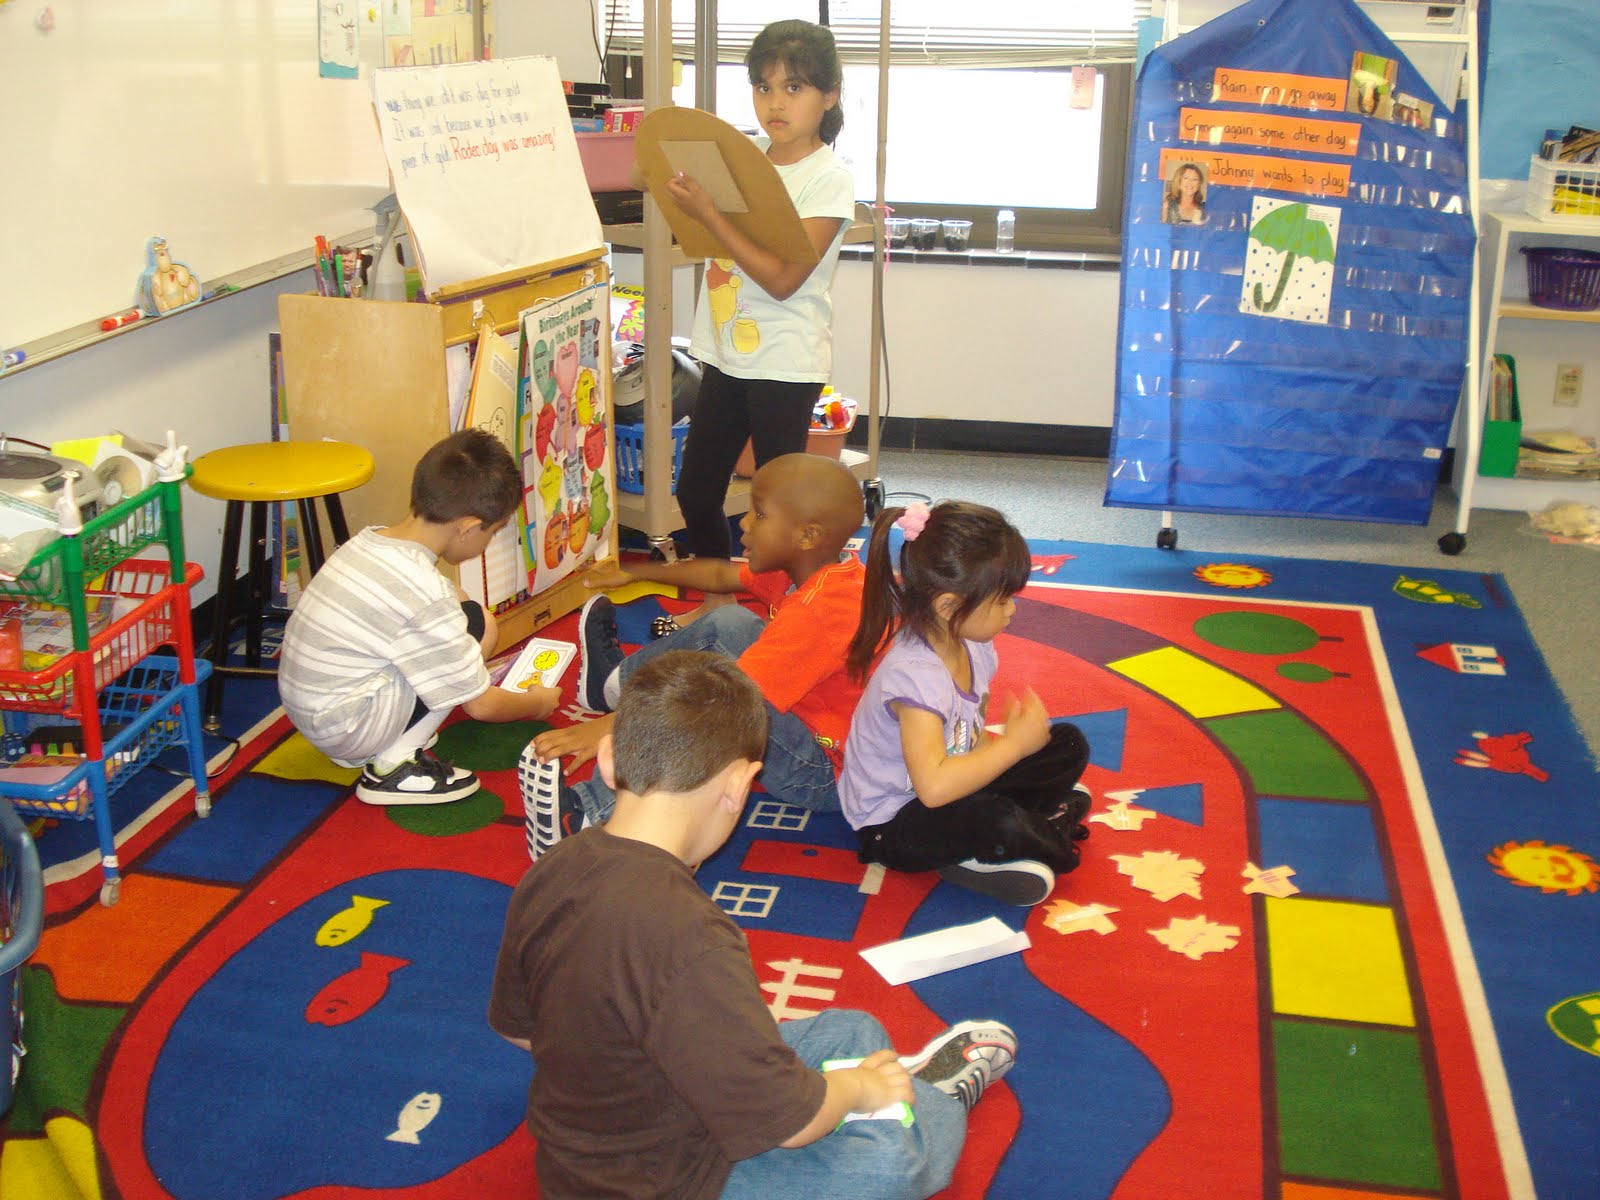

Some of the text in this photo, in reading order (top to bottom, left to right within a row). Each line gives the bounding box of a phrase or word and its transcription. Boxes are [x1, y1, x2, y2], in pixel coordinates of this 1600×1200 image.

[1221, 75, 1247, 94] Rain
[1308, 89, 1337, 107] away
[392, 117, 407, 141] It
[1224, 123, 1253, 139] again
[1259, 127, 1284, 139] some
[1293, 126, 1320, 143] other
[1326, 129, 1346, 149] day
[450, 137, 481, 161] Rodeo
[482, 136, 501, 162] day
[502, 139, 519, 153] was
[1213, 158, 1344, 193] Johnny wants to play
[539, 300, 593, 334] Birthdays Around
[556, 329, 566, 344] the
[566, 323, 579, 340] Year
